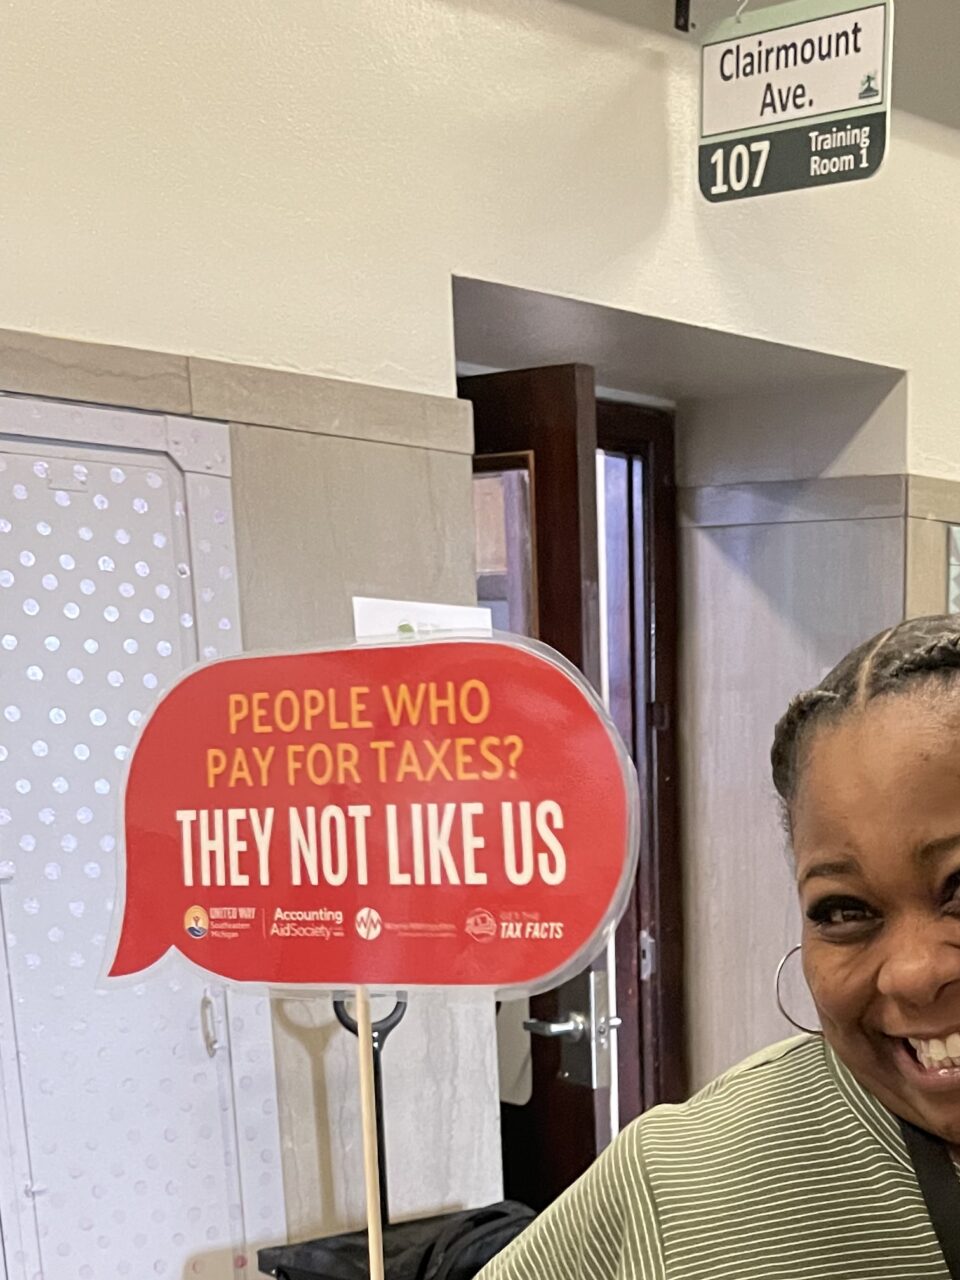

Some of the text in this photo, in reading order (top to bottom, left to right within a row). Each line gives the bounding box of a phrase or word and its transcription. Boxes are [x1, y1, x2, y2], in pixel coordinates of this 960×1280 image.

[720, 22, 862, 82] Clairmount
[760, 82, 813, 117] Ave.
[809, 125, 870, 151] Training
[710, 141, 770, 195] 107
[810, 149, 869, 176] Room 1
[229, 679, 490, 734] PEOPLE WHO
[207, 735, 524, 788] PAY FOR TAXES?
[176, 800, 567, 886] THEY NOT LIKE US
[274, 907, 343, 924] Accounting
[500, 922, 564, 939] TAX FACTS
